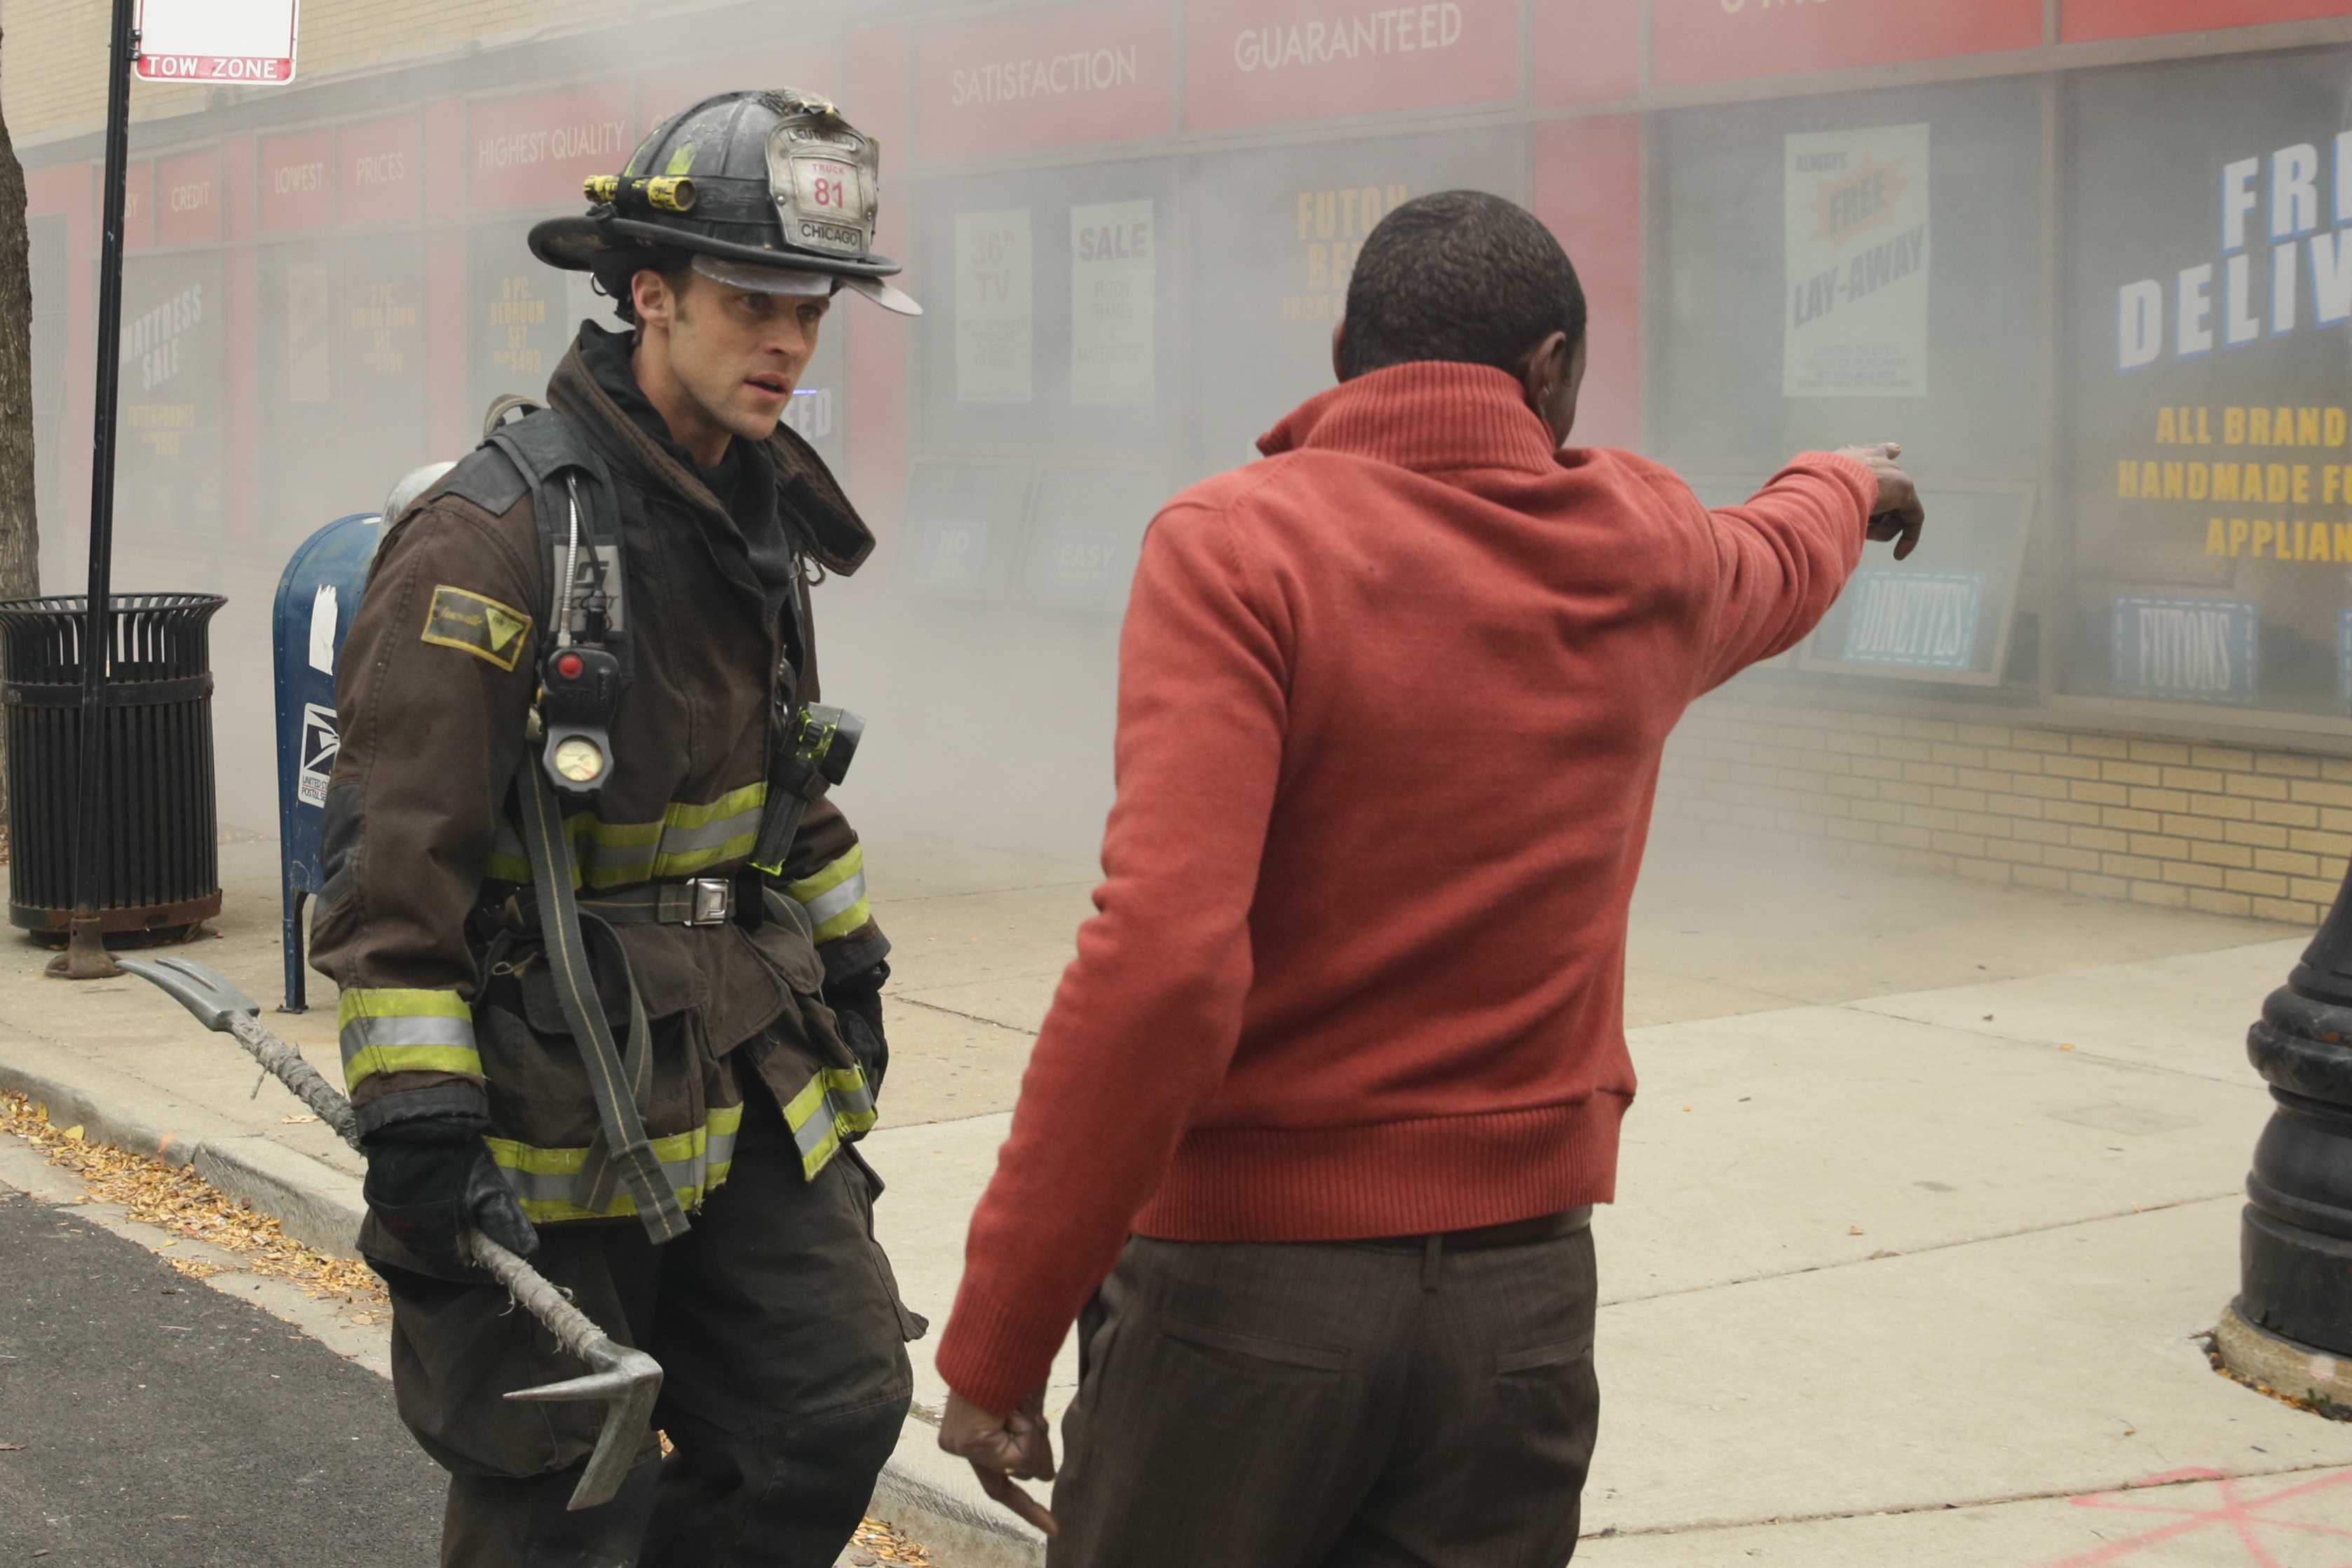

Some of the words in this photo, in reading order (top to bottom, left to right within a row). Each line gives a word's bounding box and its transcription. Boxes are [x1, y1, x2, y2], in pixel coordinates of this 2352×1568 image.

[1235, 2, 1462, 72] GUARANTEED
[147, 56, 198, 76] TOW
[212, 58, 278, 79] ZONE
[952, 45, 1136, 106] SATISFACTION
[478, 131, 548, 169] HIGHEST
[551, 121, 625, 160] QUALITY
[356, 151, 405, 185] PRICES
[812, 163, 844, 175] TRUCK
[1795, 151, 1847, 172] ALWAYS
[274, 163, 324, 195] LOWEST
[814, 178, 843, 209] 81
[171, 182, 210, 212] CREDIT
[1829, 168, 1886, 233] FREE
[801, 224, 857, 245] CHICAGO
[1078, 222, 1148, 263] SALE
[1308, 240, 1362, 290] BE
[1793, 222, 1925, 329] LAY-AWAY
[503, 278, 510, 300] 6
[514, 276, 533, 299] PC.
[974, 268, 1012, 304] TV
[1094, 280, 1129, 299] FUTON
[121, 282, 202, 365] MATTRESS
[352, 307, 383, 329] LIVING
[386, 305, 416, 328] ROOM
[490, 300, 545, 325] BEDROOM
[1090, 301, 1134, 320] FRAMES
[373, 329, 391, 351] SET
[508, 325, 528, 349] SET
[142, 337, 179, 393] SALE
[510, 350, 542, 374] $499
[2156, 406, 2212, 444] ALL
[2224, 407, 2346, 446] BRAND
[2117, 460, 2310, 503] HANDMADE
[939, 529, 970, 555] NO
[1060, 542, 1116, 569] EASY
[1857, 579, 1968, 657] DINETTES
[2139, 608, 2231, 692] FUTONS
[301, 786, 320, 800] POSTAL
[303, 775, 320, 788] UNITED
